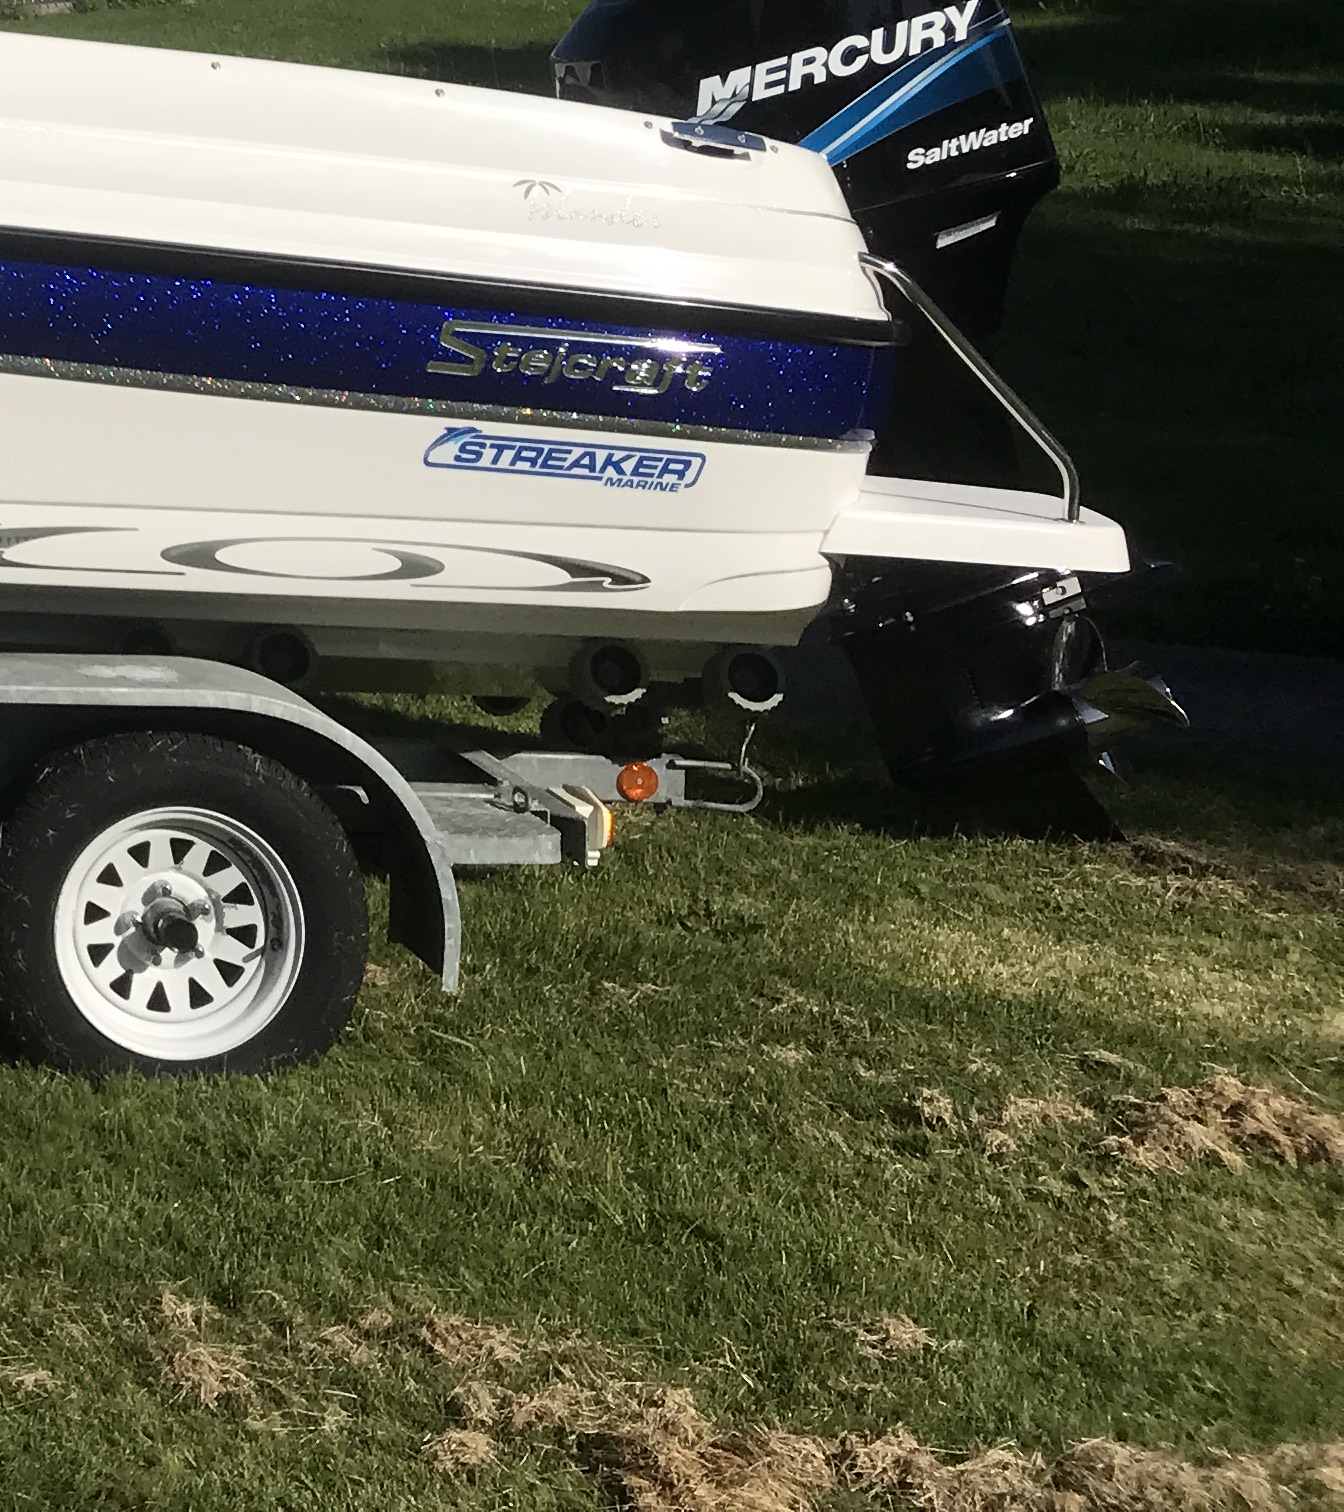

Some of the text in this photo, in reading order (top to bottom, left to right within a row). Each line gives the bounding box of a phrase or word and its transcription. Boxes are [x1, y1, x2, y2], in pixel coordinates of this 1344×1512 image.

[906, 117, 1035, 170] SaltWater
[426, 320, 723, 395] Stejcraft
[453, 439, 693, 481] STREAKER
[603, 476, 682, 493] MARINE
